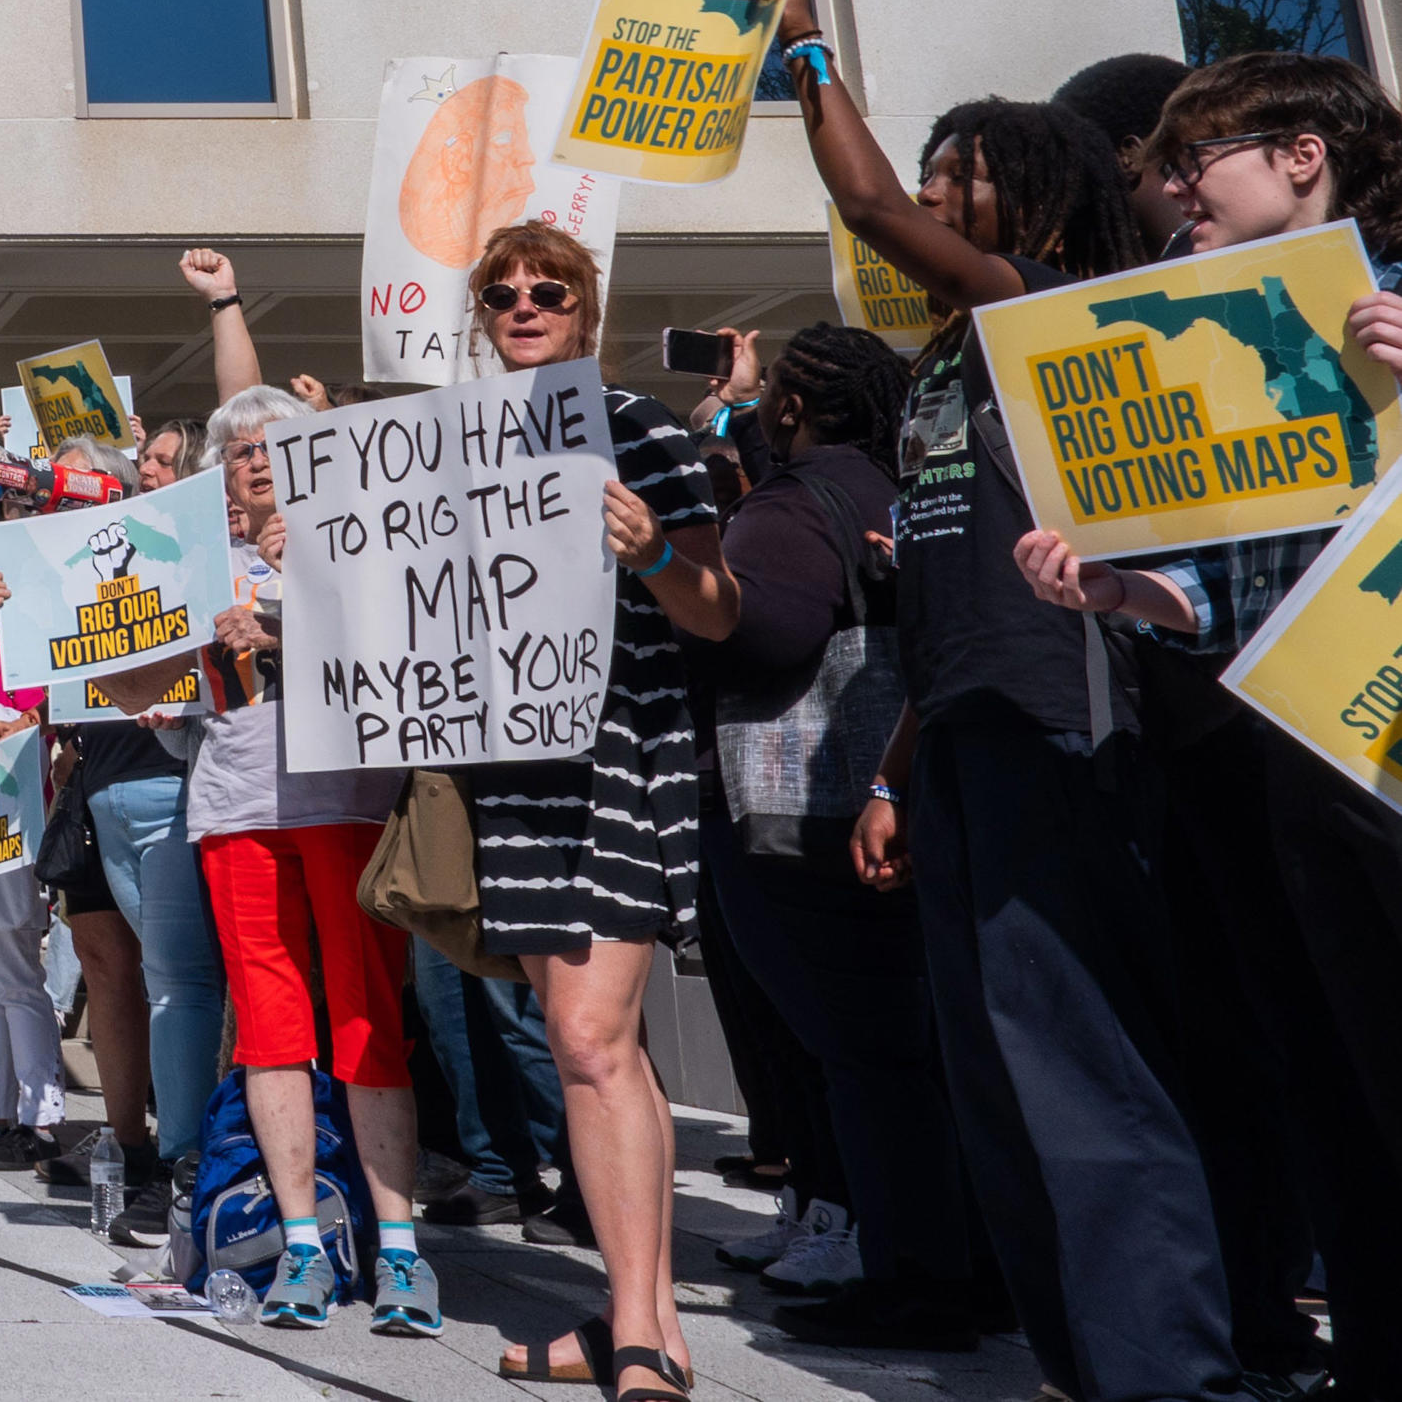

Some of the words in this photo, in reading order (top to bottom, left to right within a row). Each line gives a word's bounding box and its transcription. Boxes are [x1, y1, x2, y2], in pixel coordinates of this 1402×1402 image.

[612, 17, 662, 45] STOP
[664, 25, 701, 51] THE
[594, 47, 748, 104] PARTISAN
[578, 93, 696, 150] POWER
[856, 266, 892, 296] RIG
[1036, 341, 1149, 411] DON'T
[66, 414, 106, 439] GRAB
[276, 428, 337, 505] IF
[355, 417, 443, 492] YOU
[459, 386, 587, 468] HAVE
[1051, 406, 1117, 462] RIG
[1120, 391, 1205, 450] OUR
[1065, 448, 1207, 516] VOTING
[1211, 425, 1339, 494] MAPS
[316, 512, 367, 562] TO
[383, 495, 459, 552] RIG
[466, 471, 570, 538] THE
[79, 600, 115, 634] RIG
[120, 589, 160, 624] OUR
[101, 577, 136, 599] DON'T
[405, 553, 538, 656] MAP
[52, 627, 129, 668] VOTING
[134, 609, 189, 651] MAPS
[323, 653, 481, 715] MAYBE
[498, 627, 601, 696] YOUR
[356, 702, 488, 765] PARTY
[503, 691, 601, 748] SUCKS
